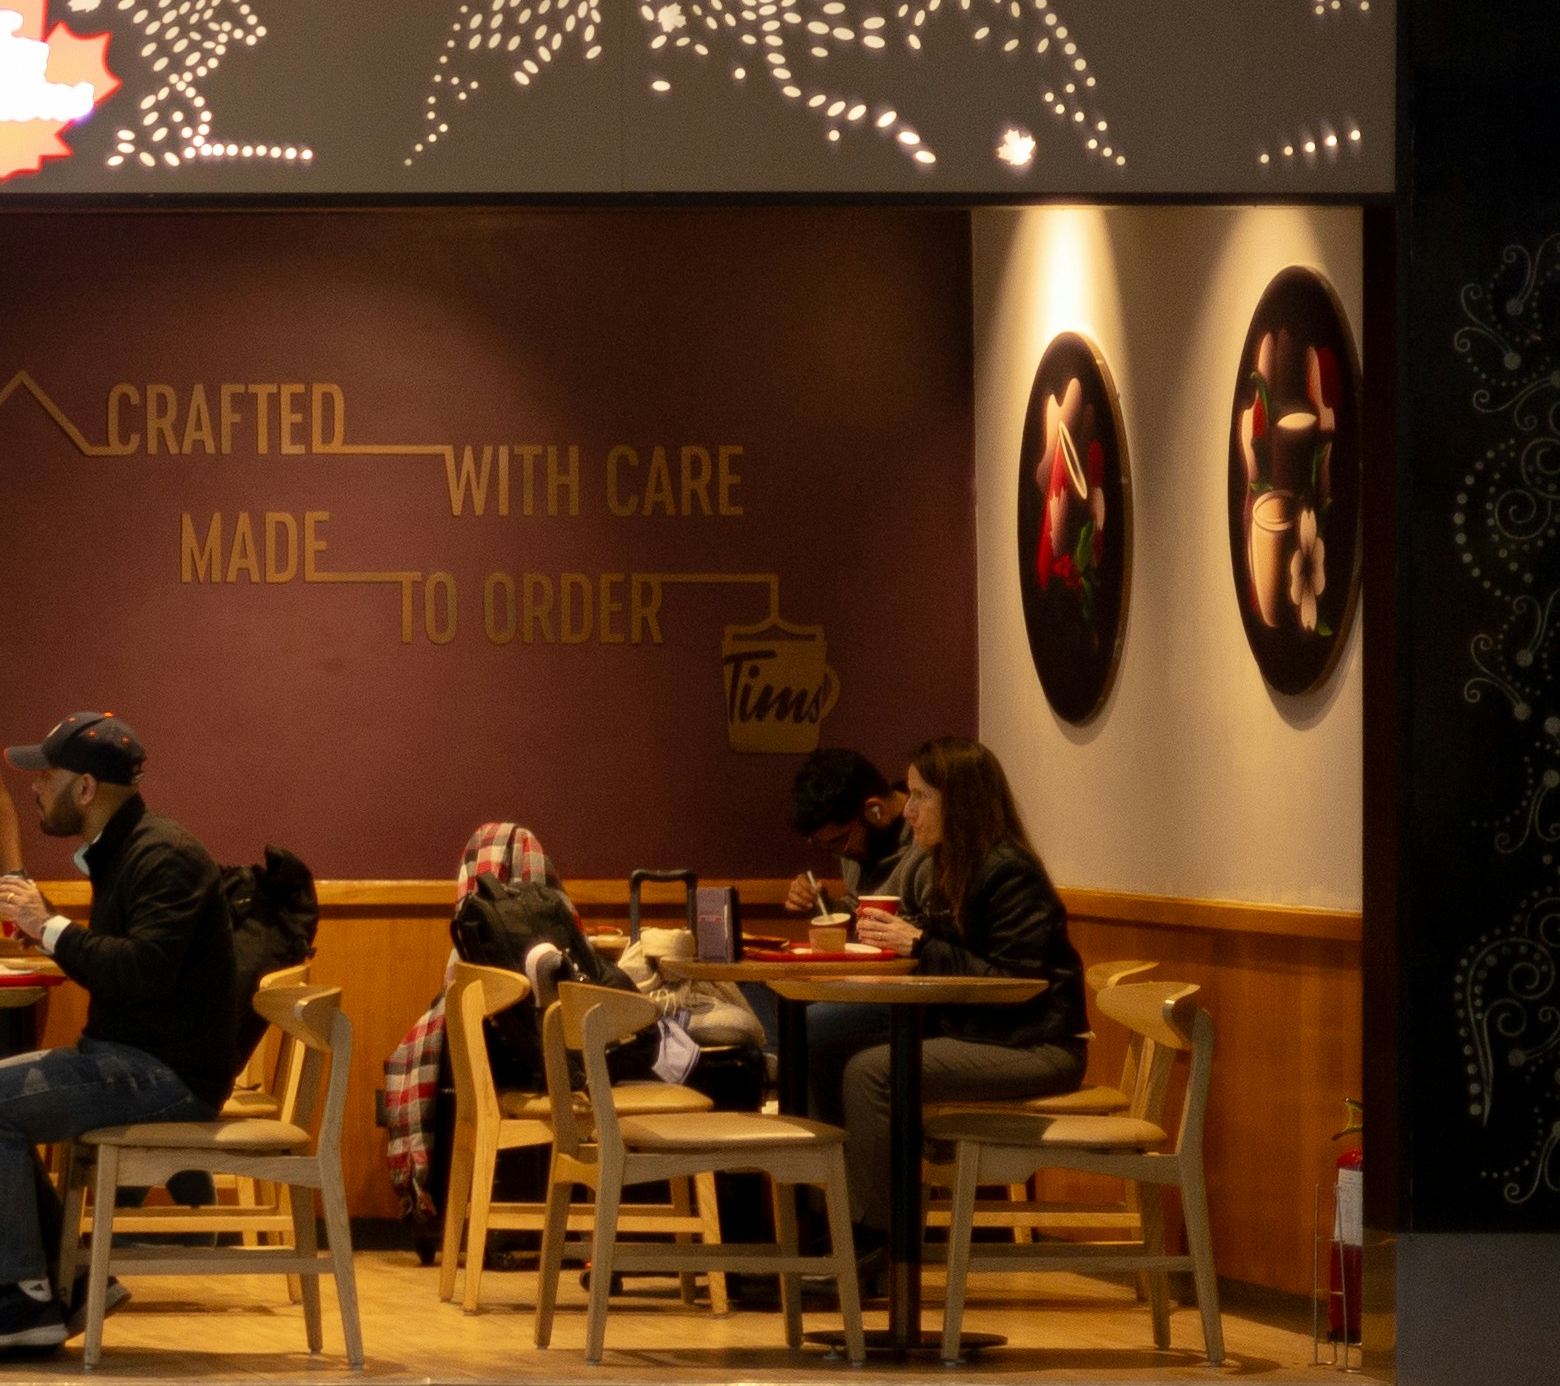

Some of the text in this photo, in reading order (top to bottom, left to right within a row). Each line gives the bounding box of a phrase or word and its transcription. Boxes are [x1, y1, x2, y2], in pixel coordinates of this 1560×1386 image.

[106, 383, 345, 455] CRAFTED
[441, 445, 745, 517] WITH CARE
[181, 511, 329, 584] MADE
[398, 571, 664, 645] TO ORDER
[723, 649, 825, 725] Tims
